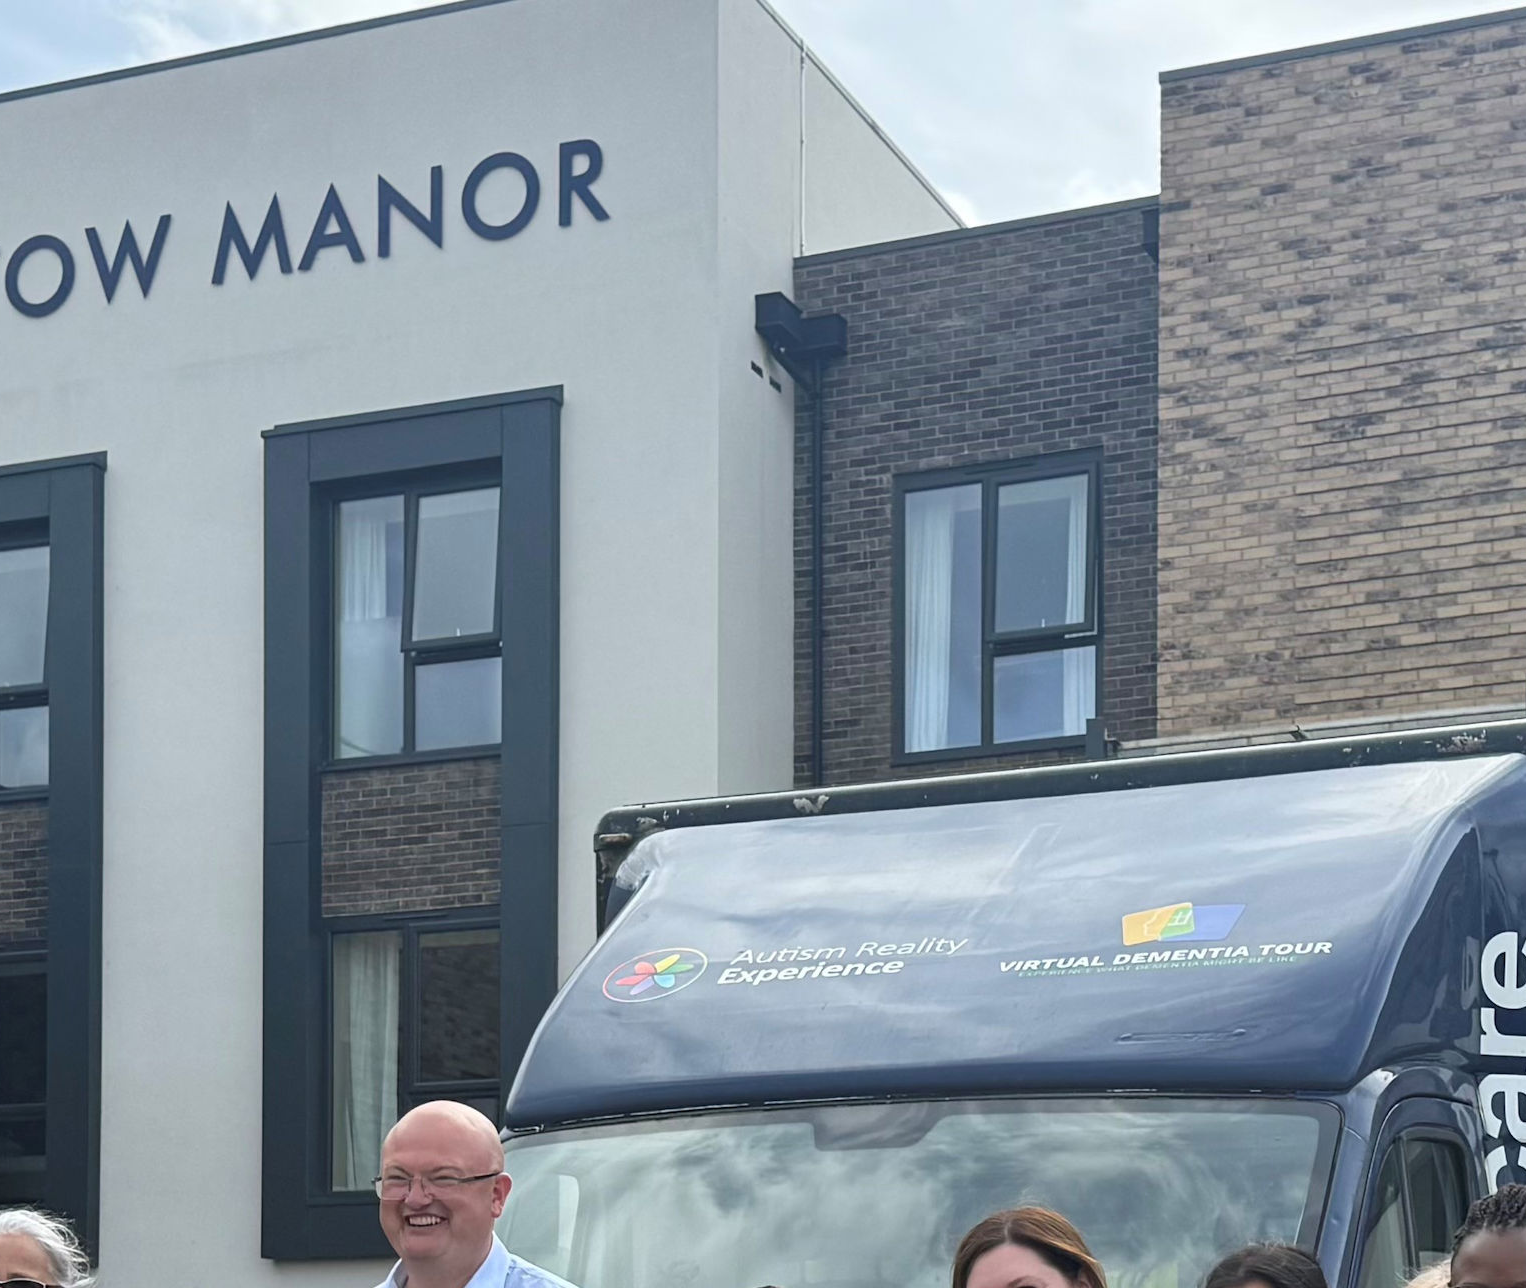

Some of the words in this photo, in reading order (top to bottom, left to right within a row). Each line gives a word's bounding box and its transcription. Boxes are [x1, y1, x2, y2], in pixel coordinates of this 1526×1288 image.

[211, 138, 611, 287] MANOR
[730, 945, 847, 966] Autism
[855, 937, 969, 958] Reality
[1000, 956, 1105, 973] VIRTUAL
[1113, 946, 1250, 966] DEMENTIA
[1259, 941, 1333, 956] TOUR
[717, 959, 905, 986] Experience
